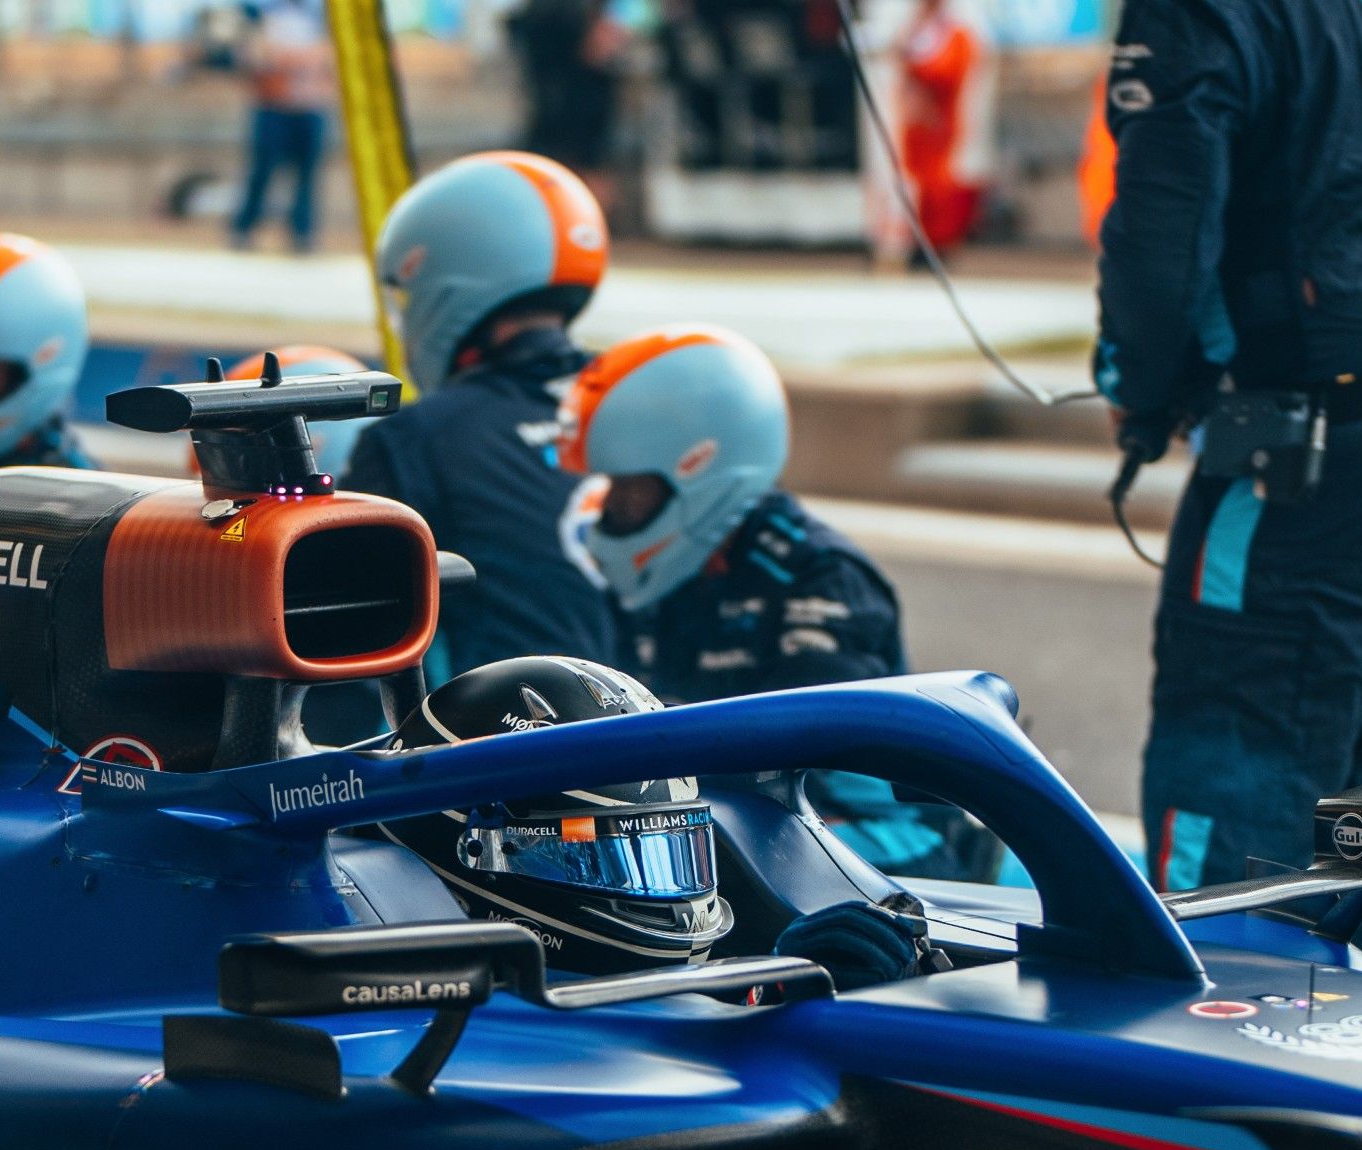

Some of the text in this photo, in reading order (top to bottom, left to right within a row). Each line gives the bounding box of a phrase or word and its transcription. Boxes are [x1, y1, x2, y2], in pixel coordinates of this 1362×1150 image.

[100, 768, 146, 791] ALBON
[269, 769, 365, 823] Jumeirah
[506, 825, 558, 837] DURACELL
[342, 979, 471, 1005] causaLens
